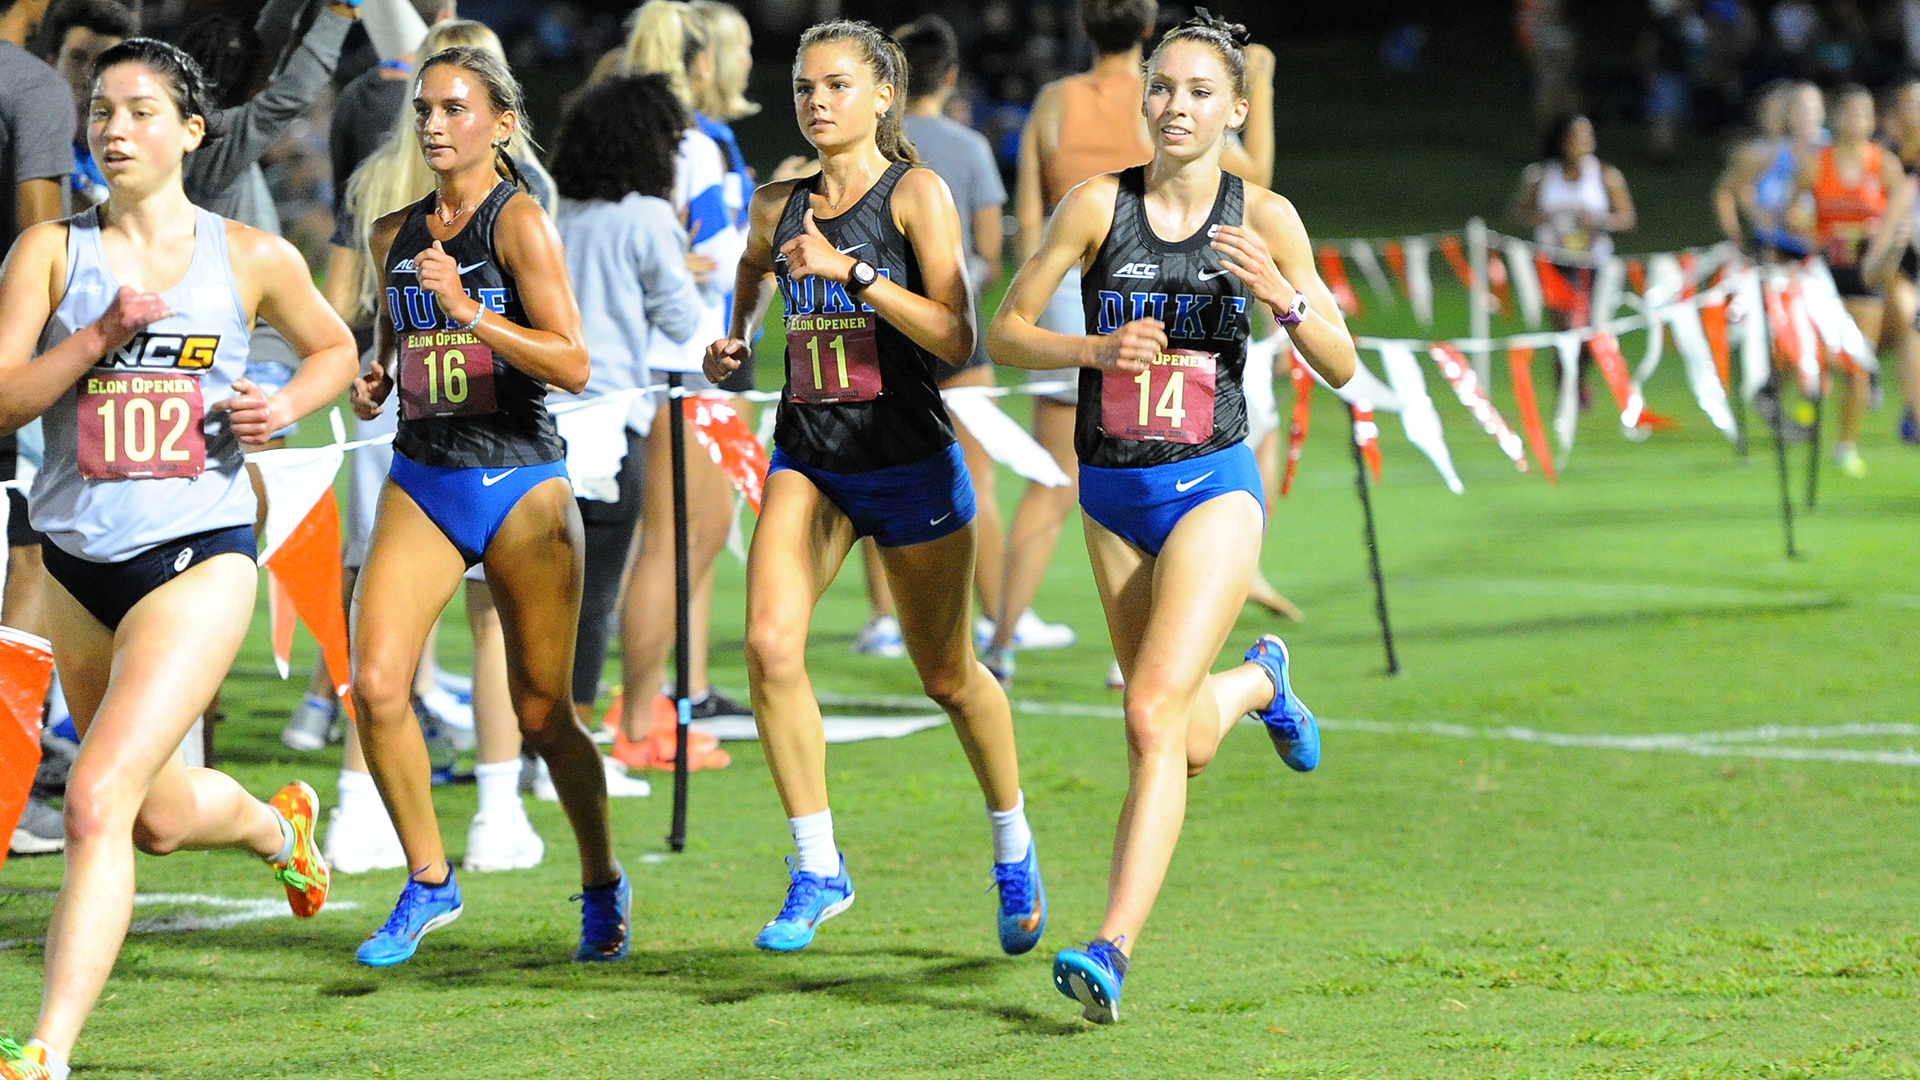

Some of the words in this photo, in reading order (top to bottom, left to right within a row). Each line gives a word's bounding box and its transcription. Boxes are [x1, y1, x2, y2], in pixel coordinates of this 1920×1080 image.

[396, 259, 419, 270] AC
[1115, 263, 1159, 277] ACC
[776, 268, 890, 317] DUK
[791, 318, 814, 331] ELON
[816, 317, 867, 331] OPENER
[1097, 290, 1246, 341] DUKE
[95, 332, 221, 370] NCG
[407, 335, 434, 349] ELON
[806, 334, 850, 390] 11
[88, 378, 128, 394] ELON
[131, 377, 194, 393] OPENER
[423, 349, 469, 404] 16
[1134, 370, 1187, 428] 14
[97, 397, 191, 462] 102
